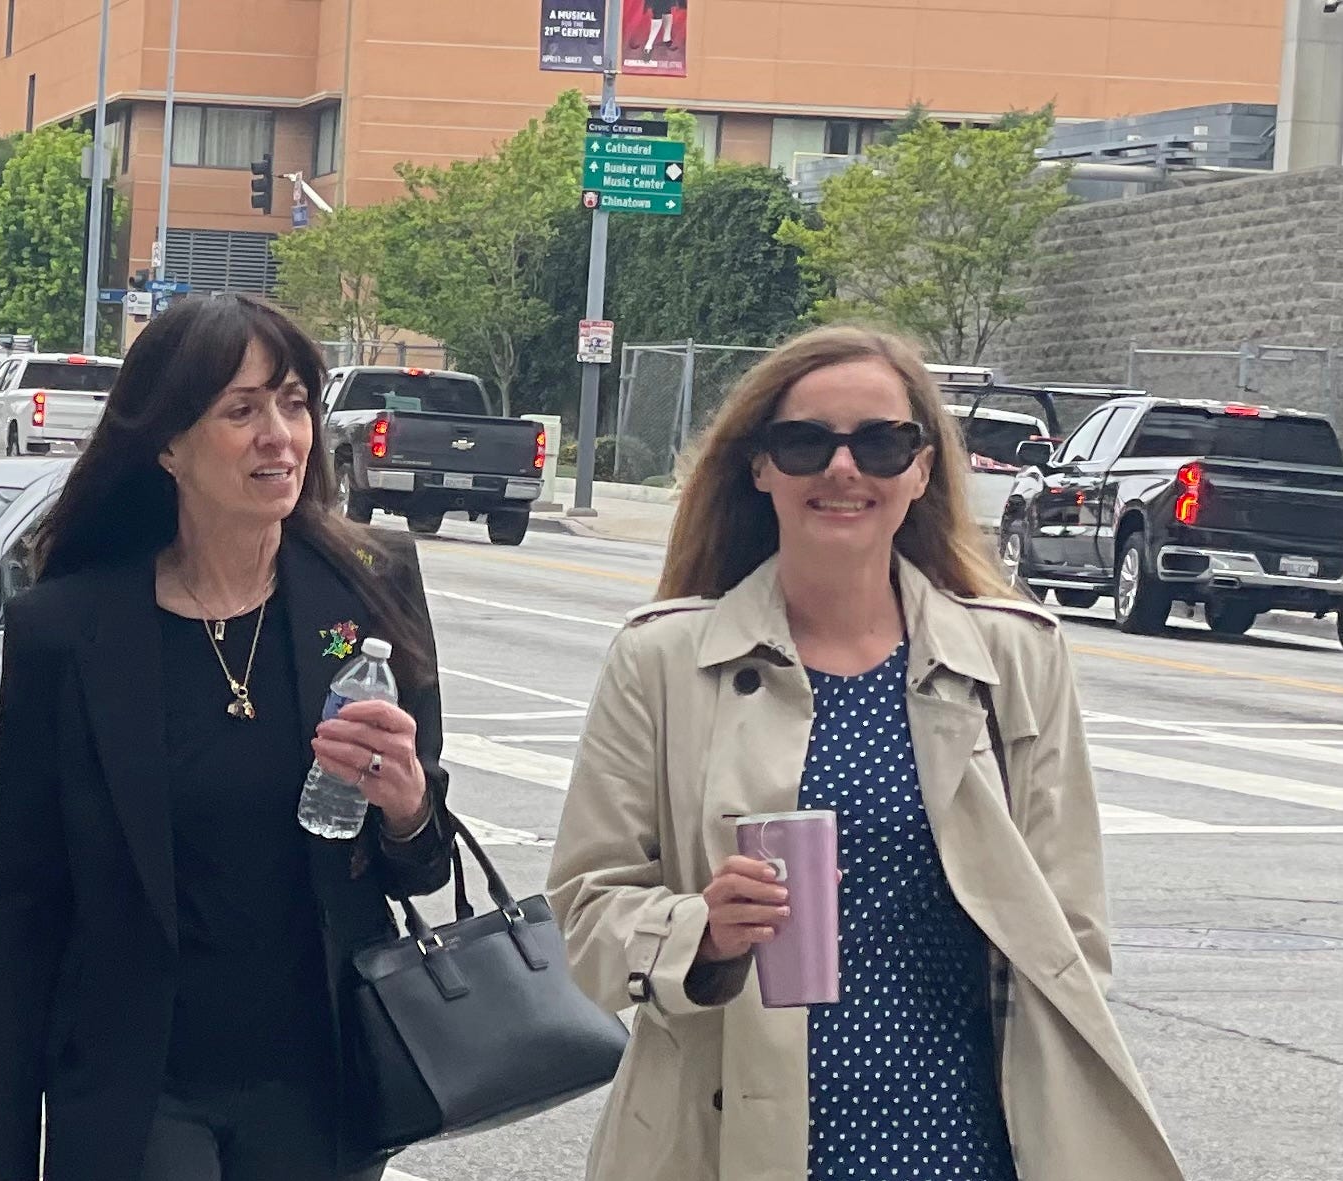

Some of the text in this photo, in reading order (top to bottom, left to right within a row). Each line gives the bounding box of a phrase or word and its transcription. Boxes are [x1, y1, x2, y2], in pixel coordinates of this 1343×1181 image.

[549, 10, 597, 21] A MUSICAL
[561, 27, 601, 39] CENTURY
[605, 142, 652, 155] Cathedral
[604, 162, 657, 176] Bunker Hill
[603, 175, 666, 190] Music Center
[601, 195, 652, 209] Chinatown
